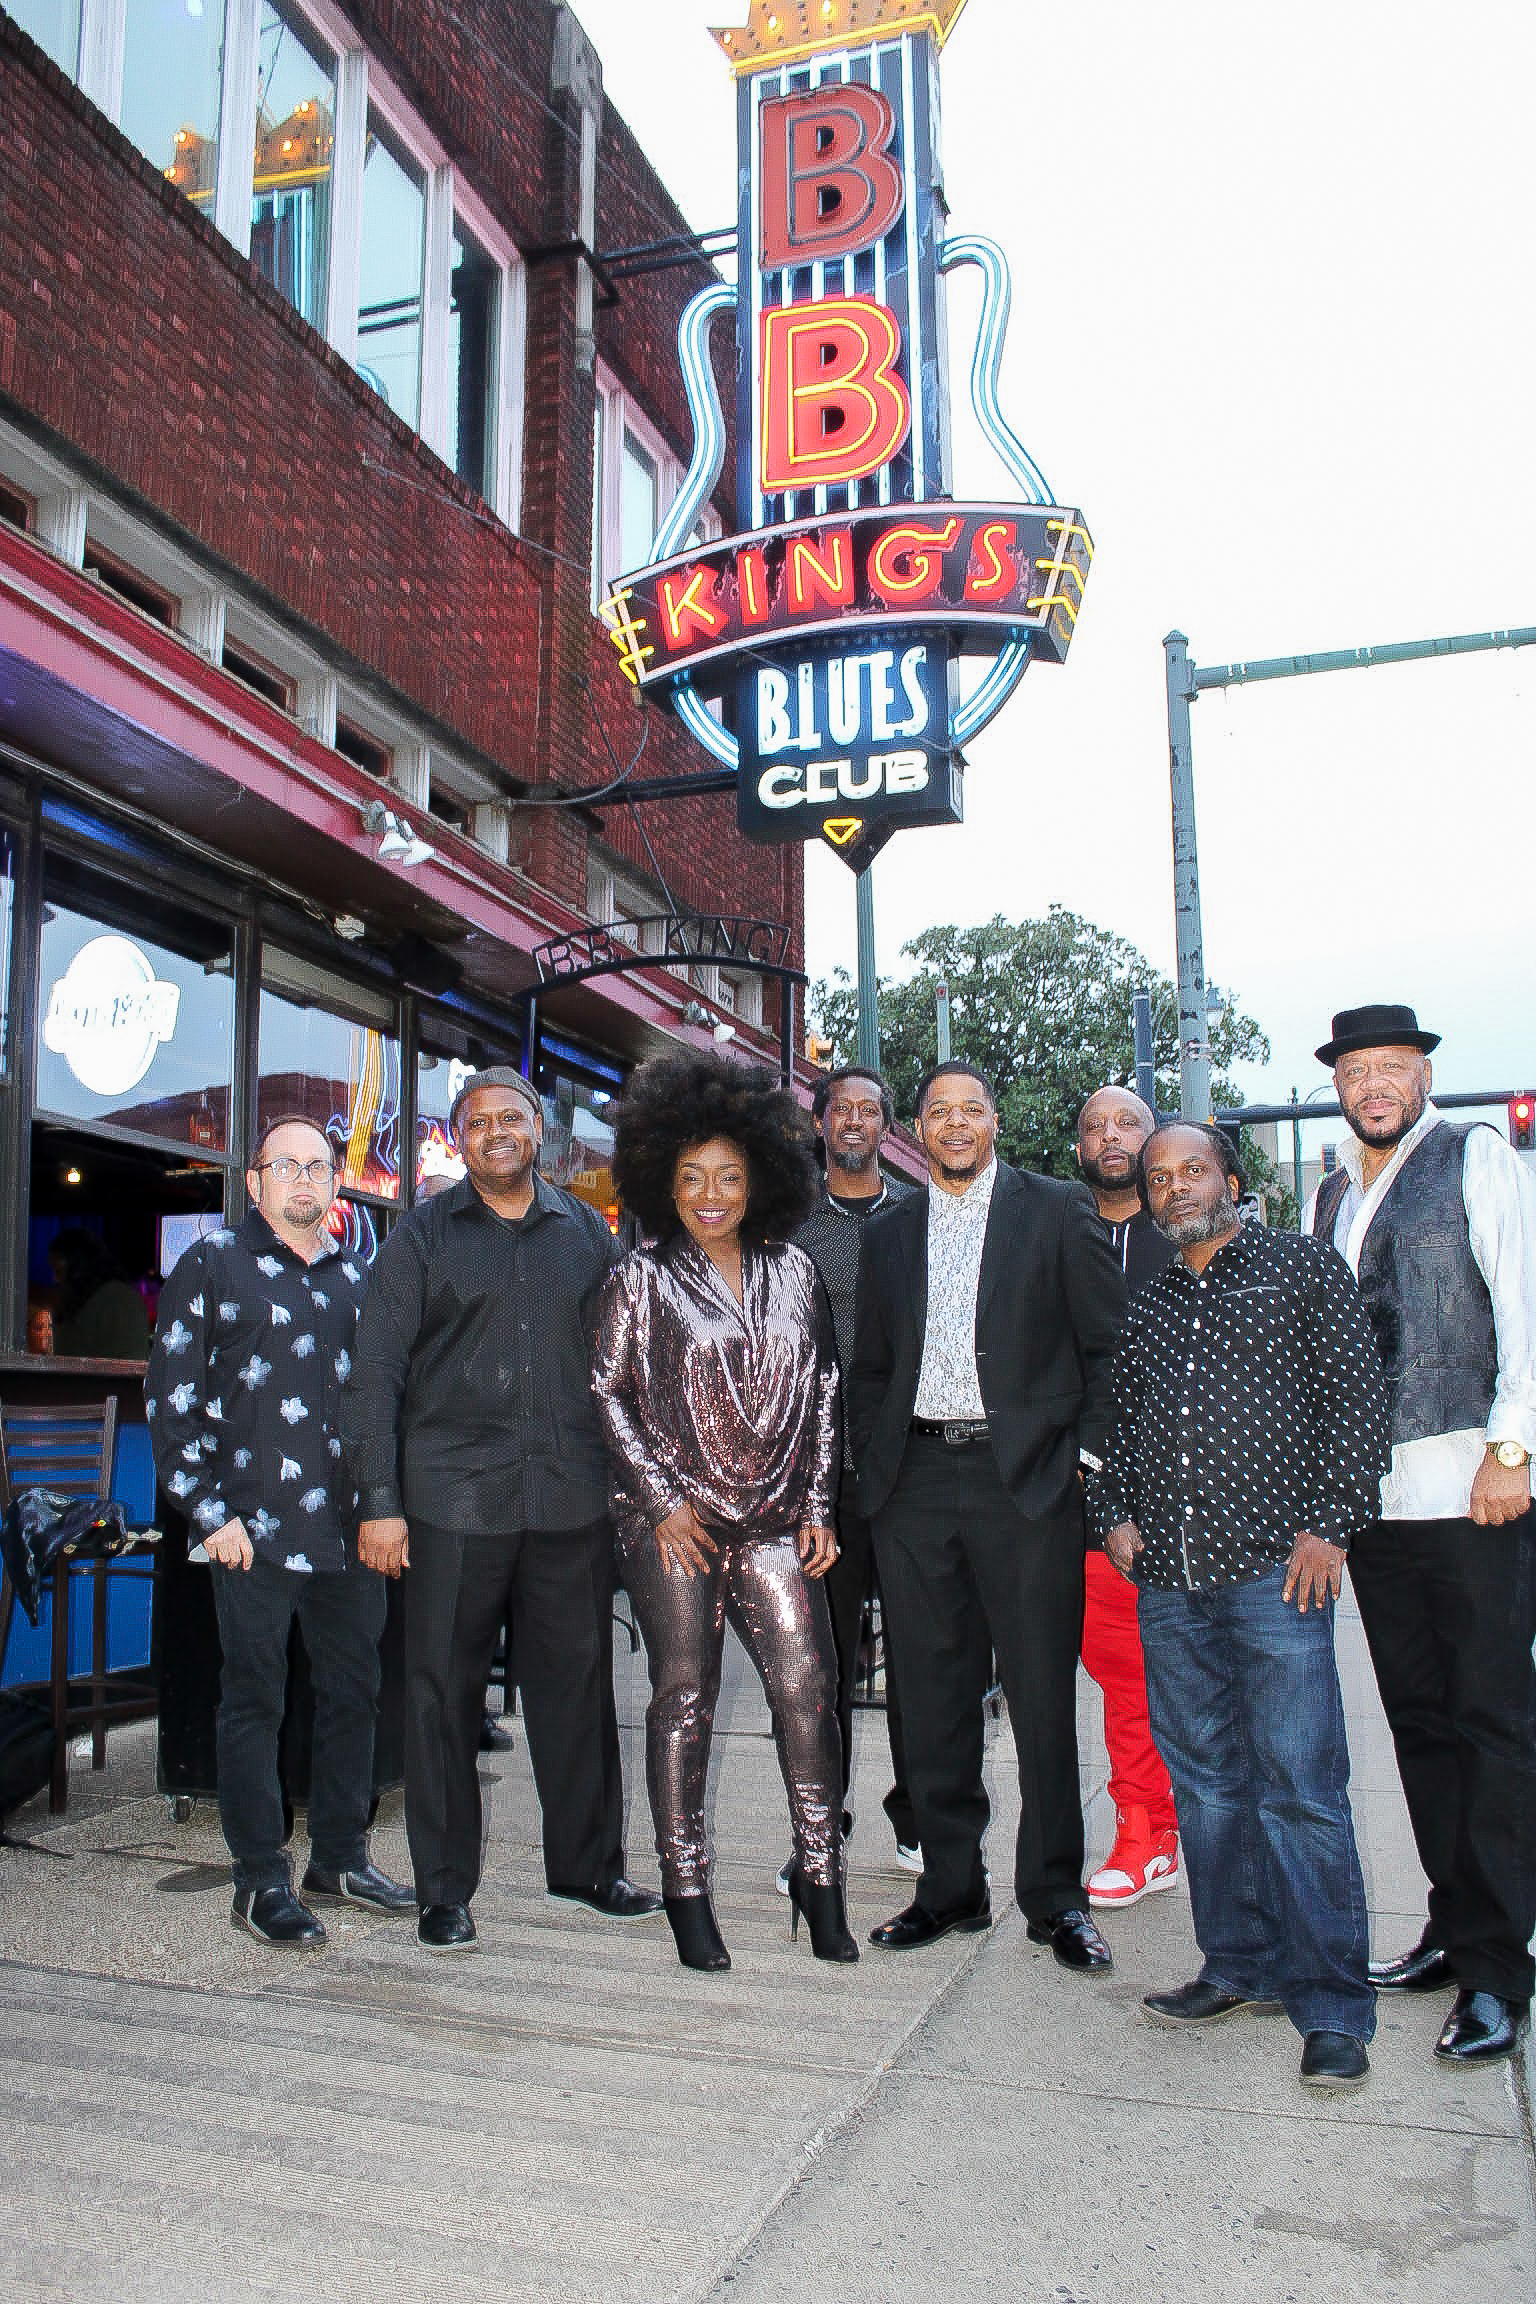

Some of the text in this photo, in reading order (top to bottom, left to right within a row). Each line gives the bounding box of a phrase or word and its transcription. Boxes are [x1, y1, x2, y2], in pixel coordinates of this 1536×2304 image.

[655, 517, 1018, 651] KING'S
[756, 644, 929, 757] BLUES
[756, 749, 931, 809] CLUB
